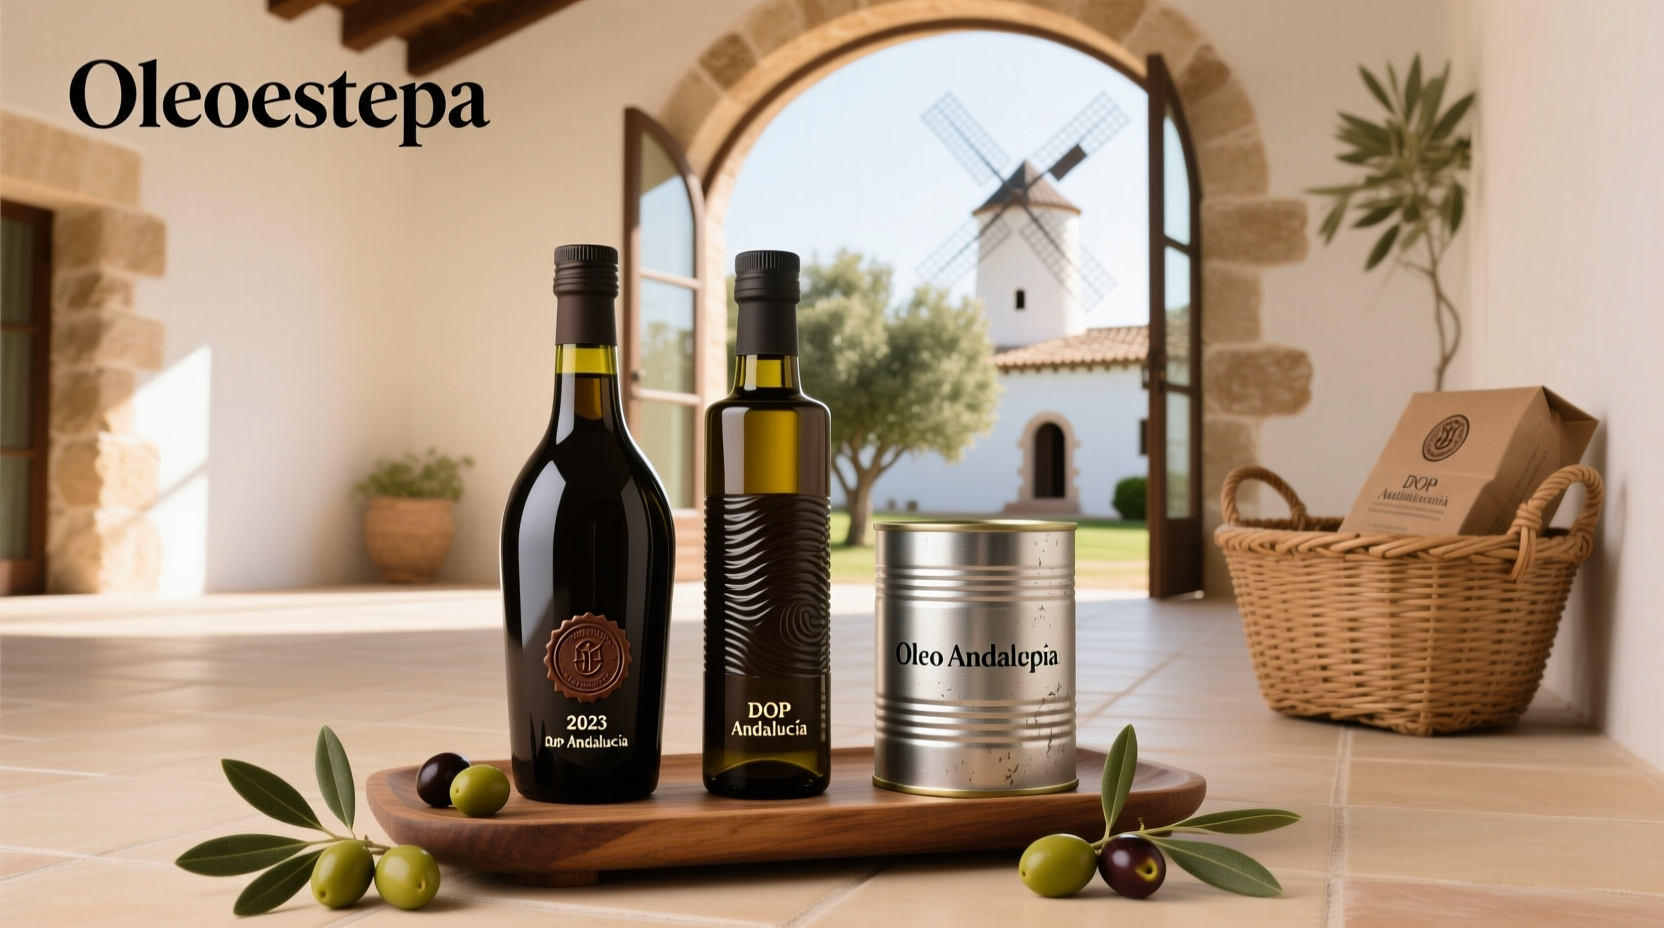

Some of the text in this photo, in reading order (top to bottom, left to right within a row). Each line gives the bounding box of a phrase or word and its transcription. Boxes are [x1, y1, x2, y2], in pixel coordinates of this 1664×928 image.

[896, 642, 944, 666] Oleo
[747, 701, 792, 719] DOP
[566, 715, 608, 730] 2023
[730, 719, 808, 737] Andalucía
